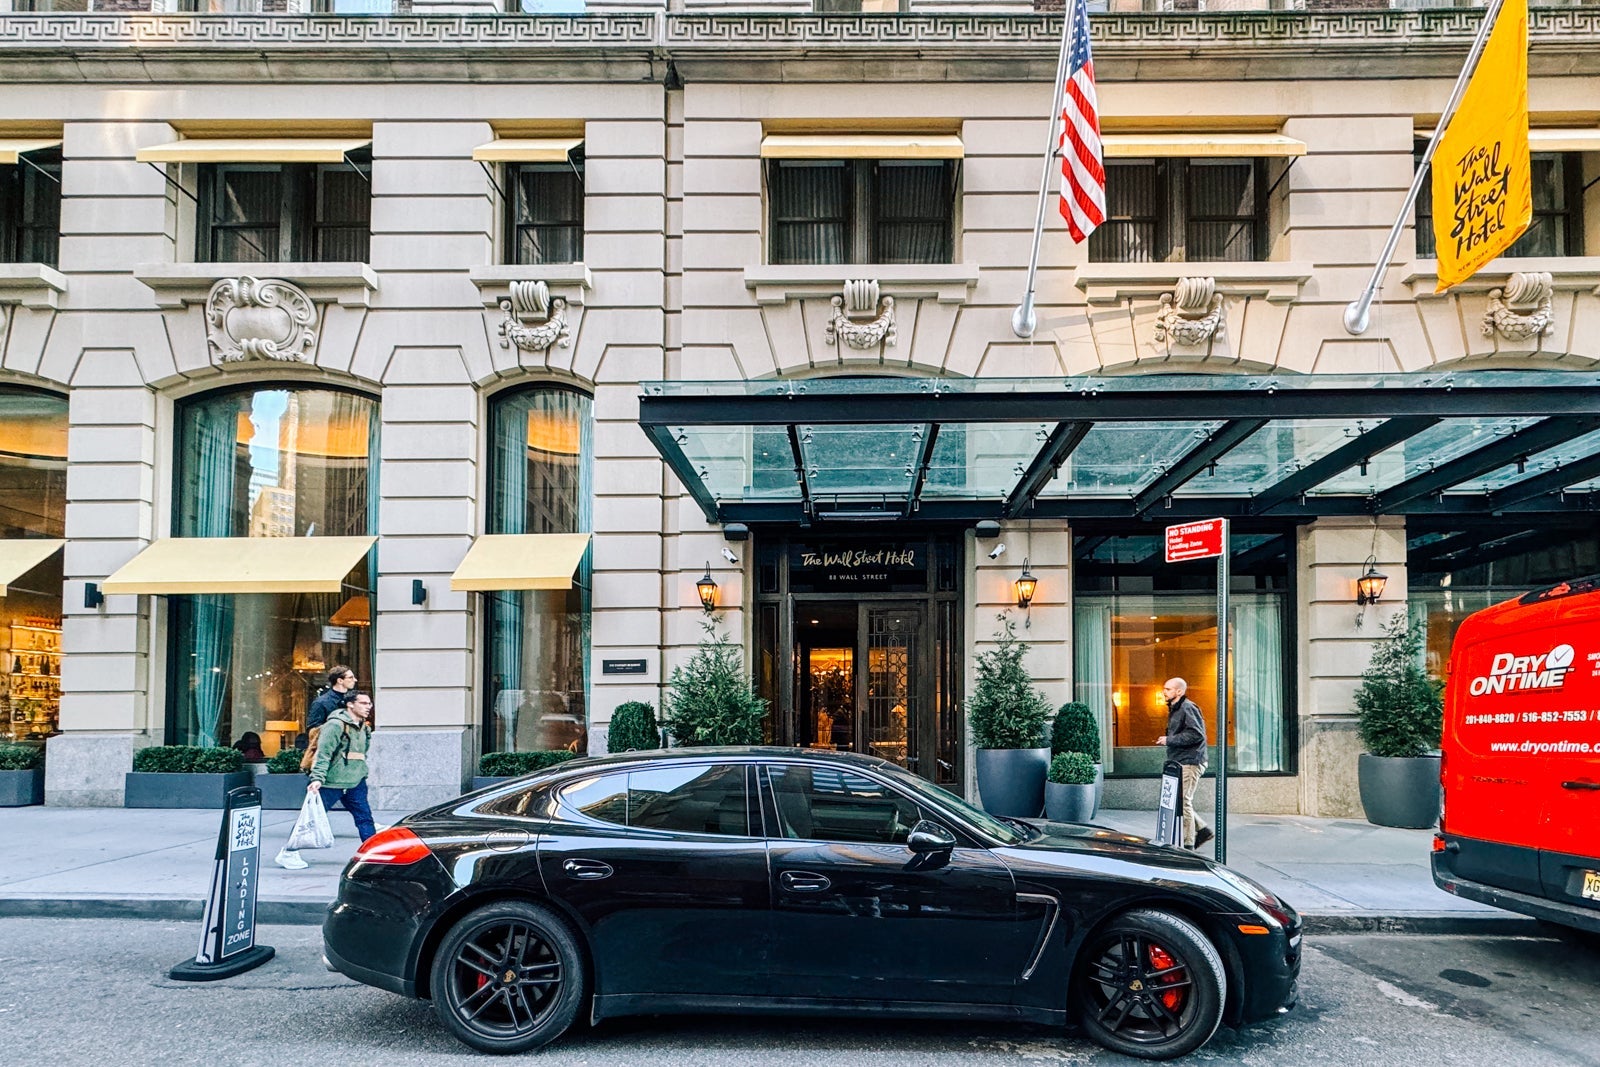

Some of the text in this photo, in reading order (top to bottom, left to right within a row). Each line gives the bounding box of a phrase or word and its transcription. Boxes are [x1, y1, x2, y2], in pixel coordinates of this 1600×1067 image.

[1455, 141, 1501, 205] Wall
[1457, 145, 1488, 177] The
[1451, 163, 1512, 239] Street
[1456, 200, 1505, 259] Hotel
[1169, 523, 1214, 537] NO STANDING
[801, 550, 915, 568] The Wall Street Hotel
[1490, 652, 1549, 676] DRY
[1469, 669, 1568, 696] ONTIME
[1522, 710, 1587, 723] 516-852-7553
[237, 857, 249, 930] LOADING
[227, 929, 250, 946] ZONE
